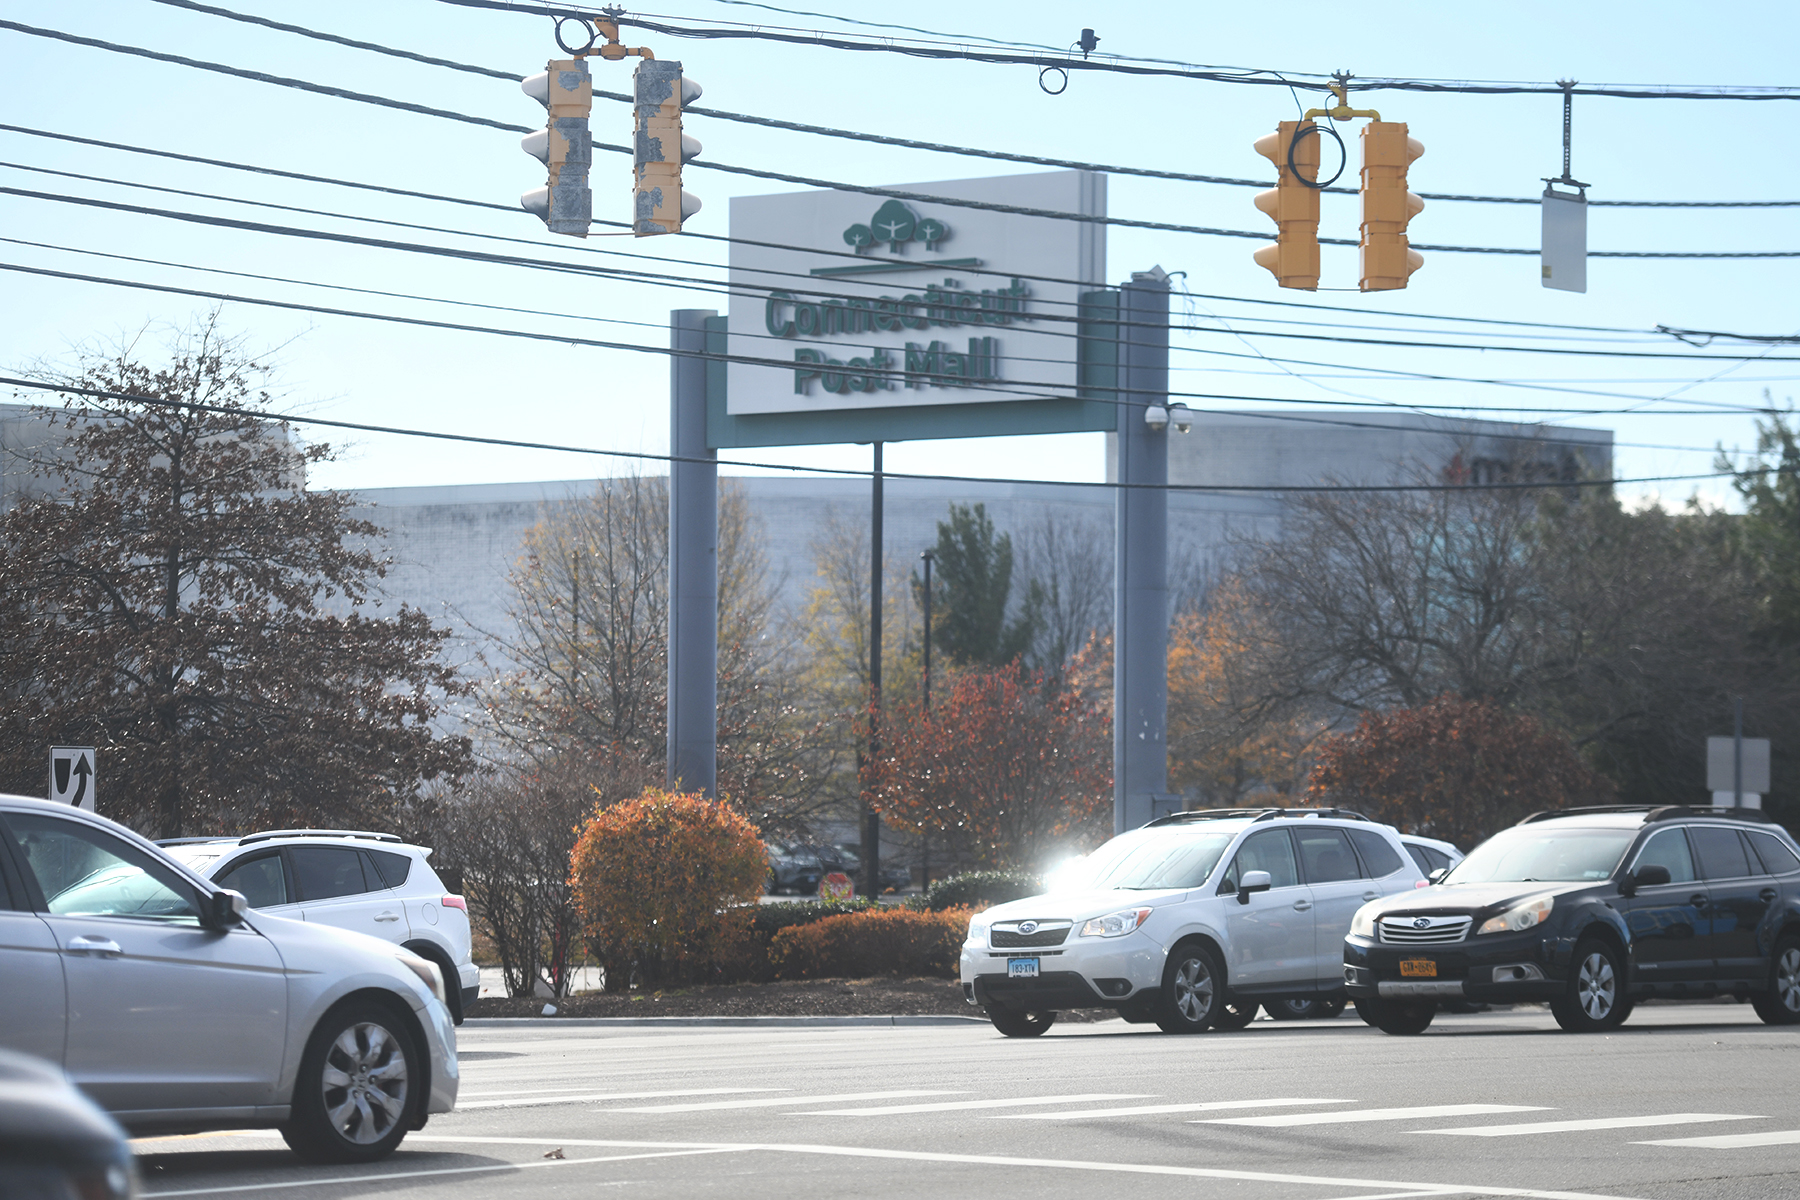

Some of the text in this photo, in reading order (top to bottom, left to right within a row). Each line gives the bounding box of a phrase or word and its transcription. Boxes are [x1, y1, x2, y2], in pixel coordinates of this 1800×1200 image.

[765, 278, 1029, 337] Connecticut
[794, 336, 994, 394] Post Mall
